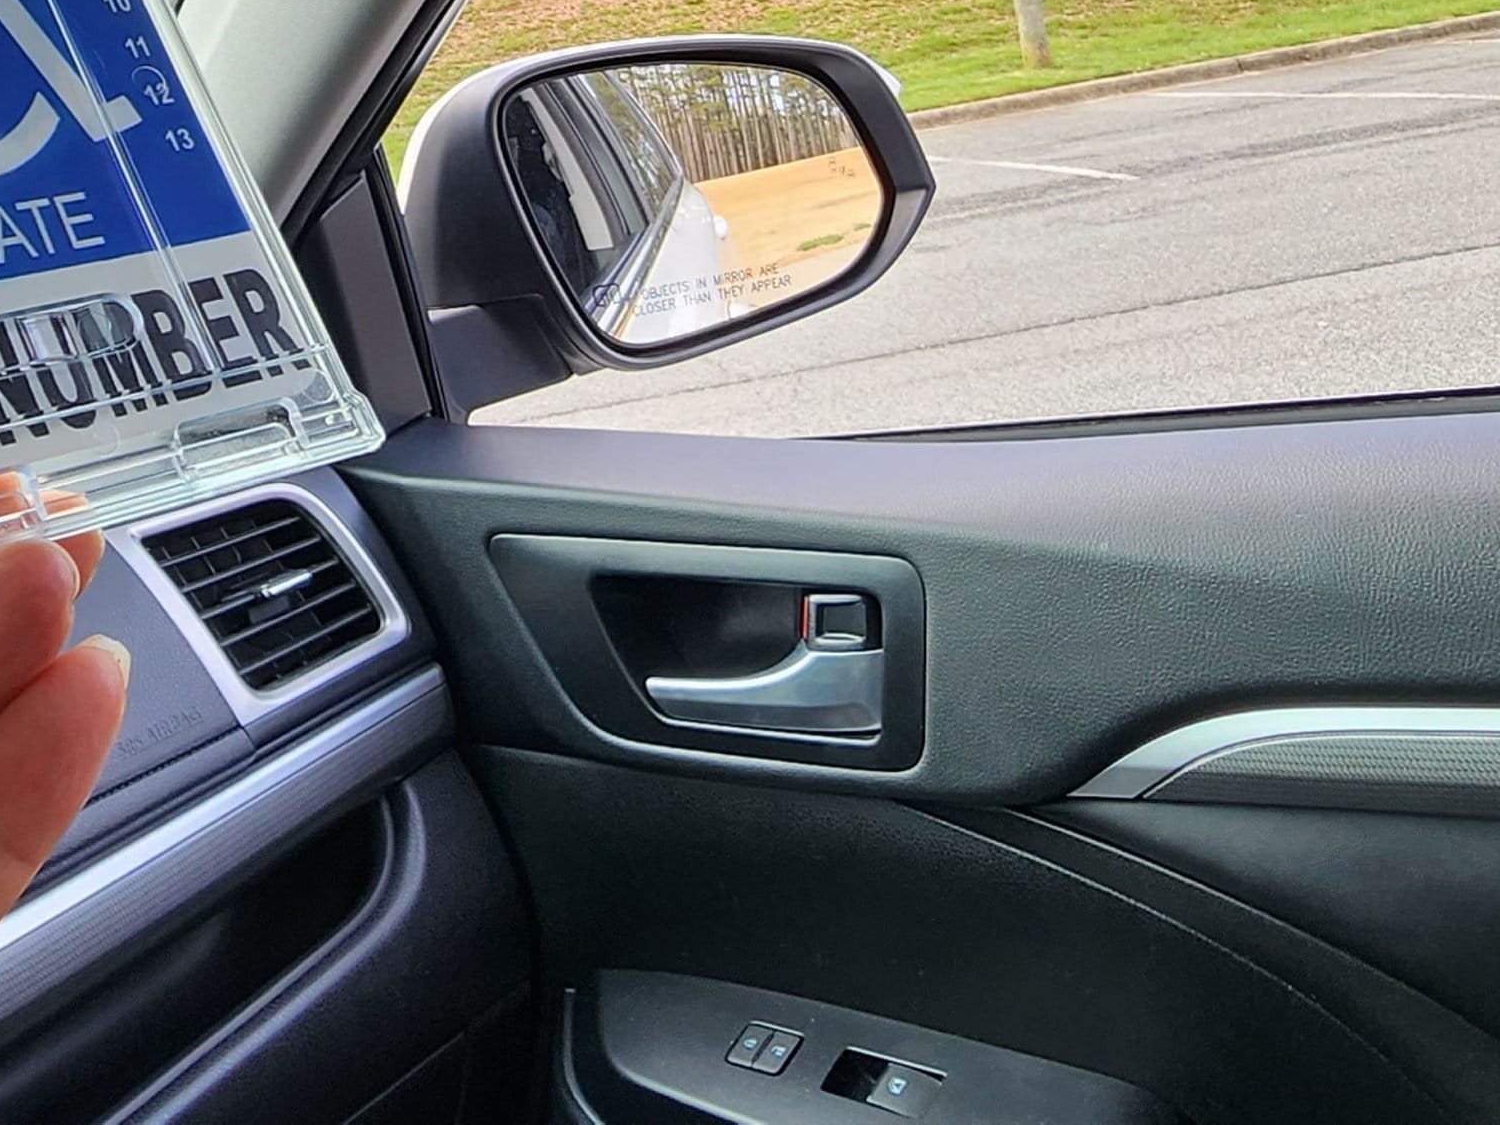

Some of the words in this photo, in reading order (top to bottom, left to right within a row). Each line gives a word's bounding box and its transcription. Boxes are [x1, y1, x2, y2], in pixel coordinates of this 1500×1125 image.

[125, 36, 151, 59] 11
[144, 83, 175, 105] 12
[165, 128, 195, 151] 13
[641, 280, 690, 301] OBJECTS
[696, 278, 707, 289] IN
[713, 268, 754, 285] MIRROR
[759, 262, 780, 276] ARE
[634, 297, 677, 317] CLOSER
[683, 291, 712, 307] THAN
[718, 284, 745, 299] THEY
[751, 274, 792, 293] APPEAR
